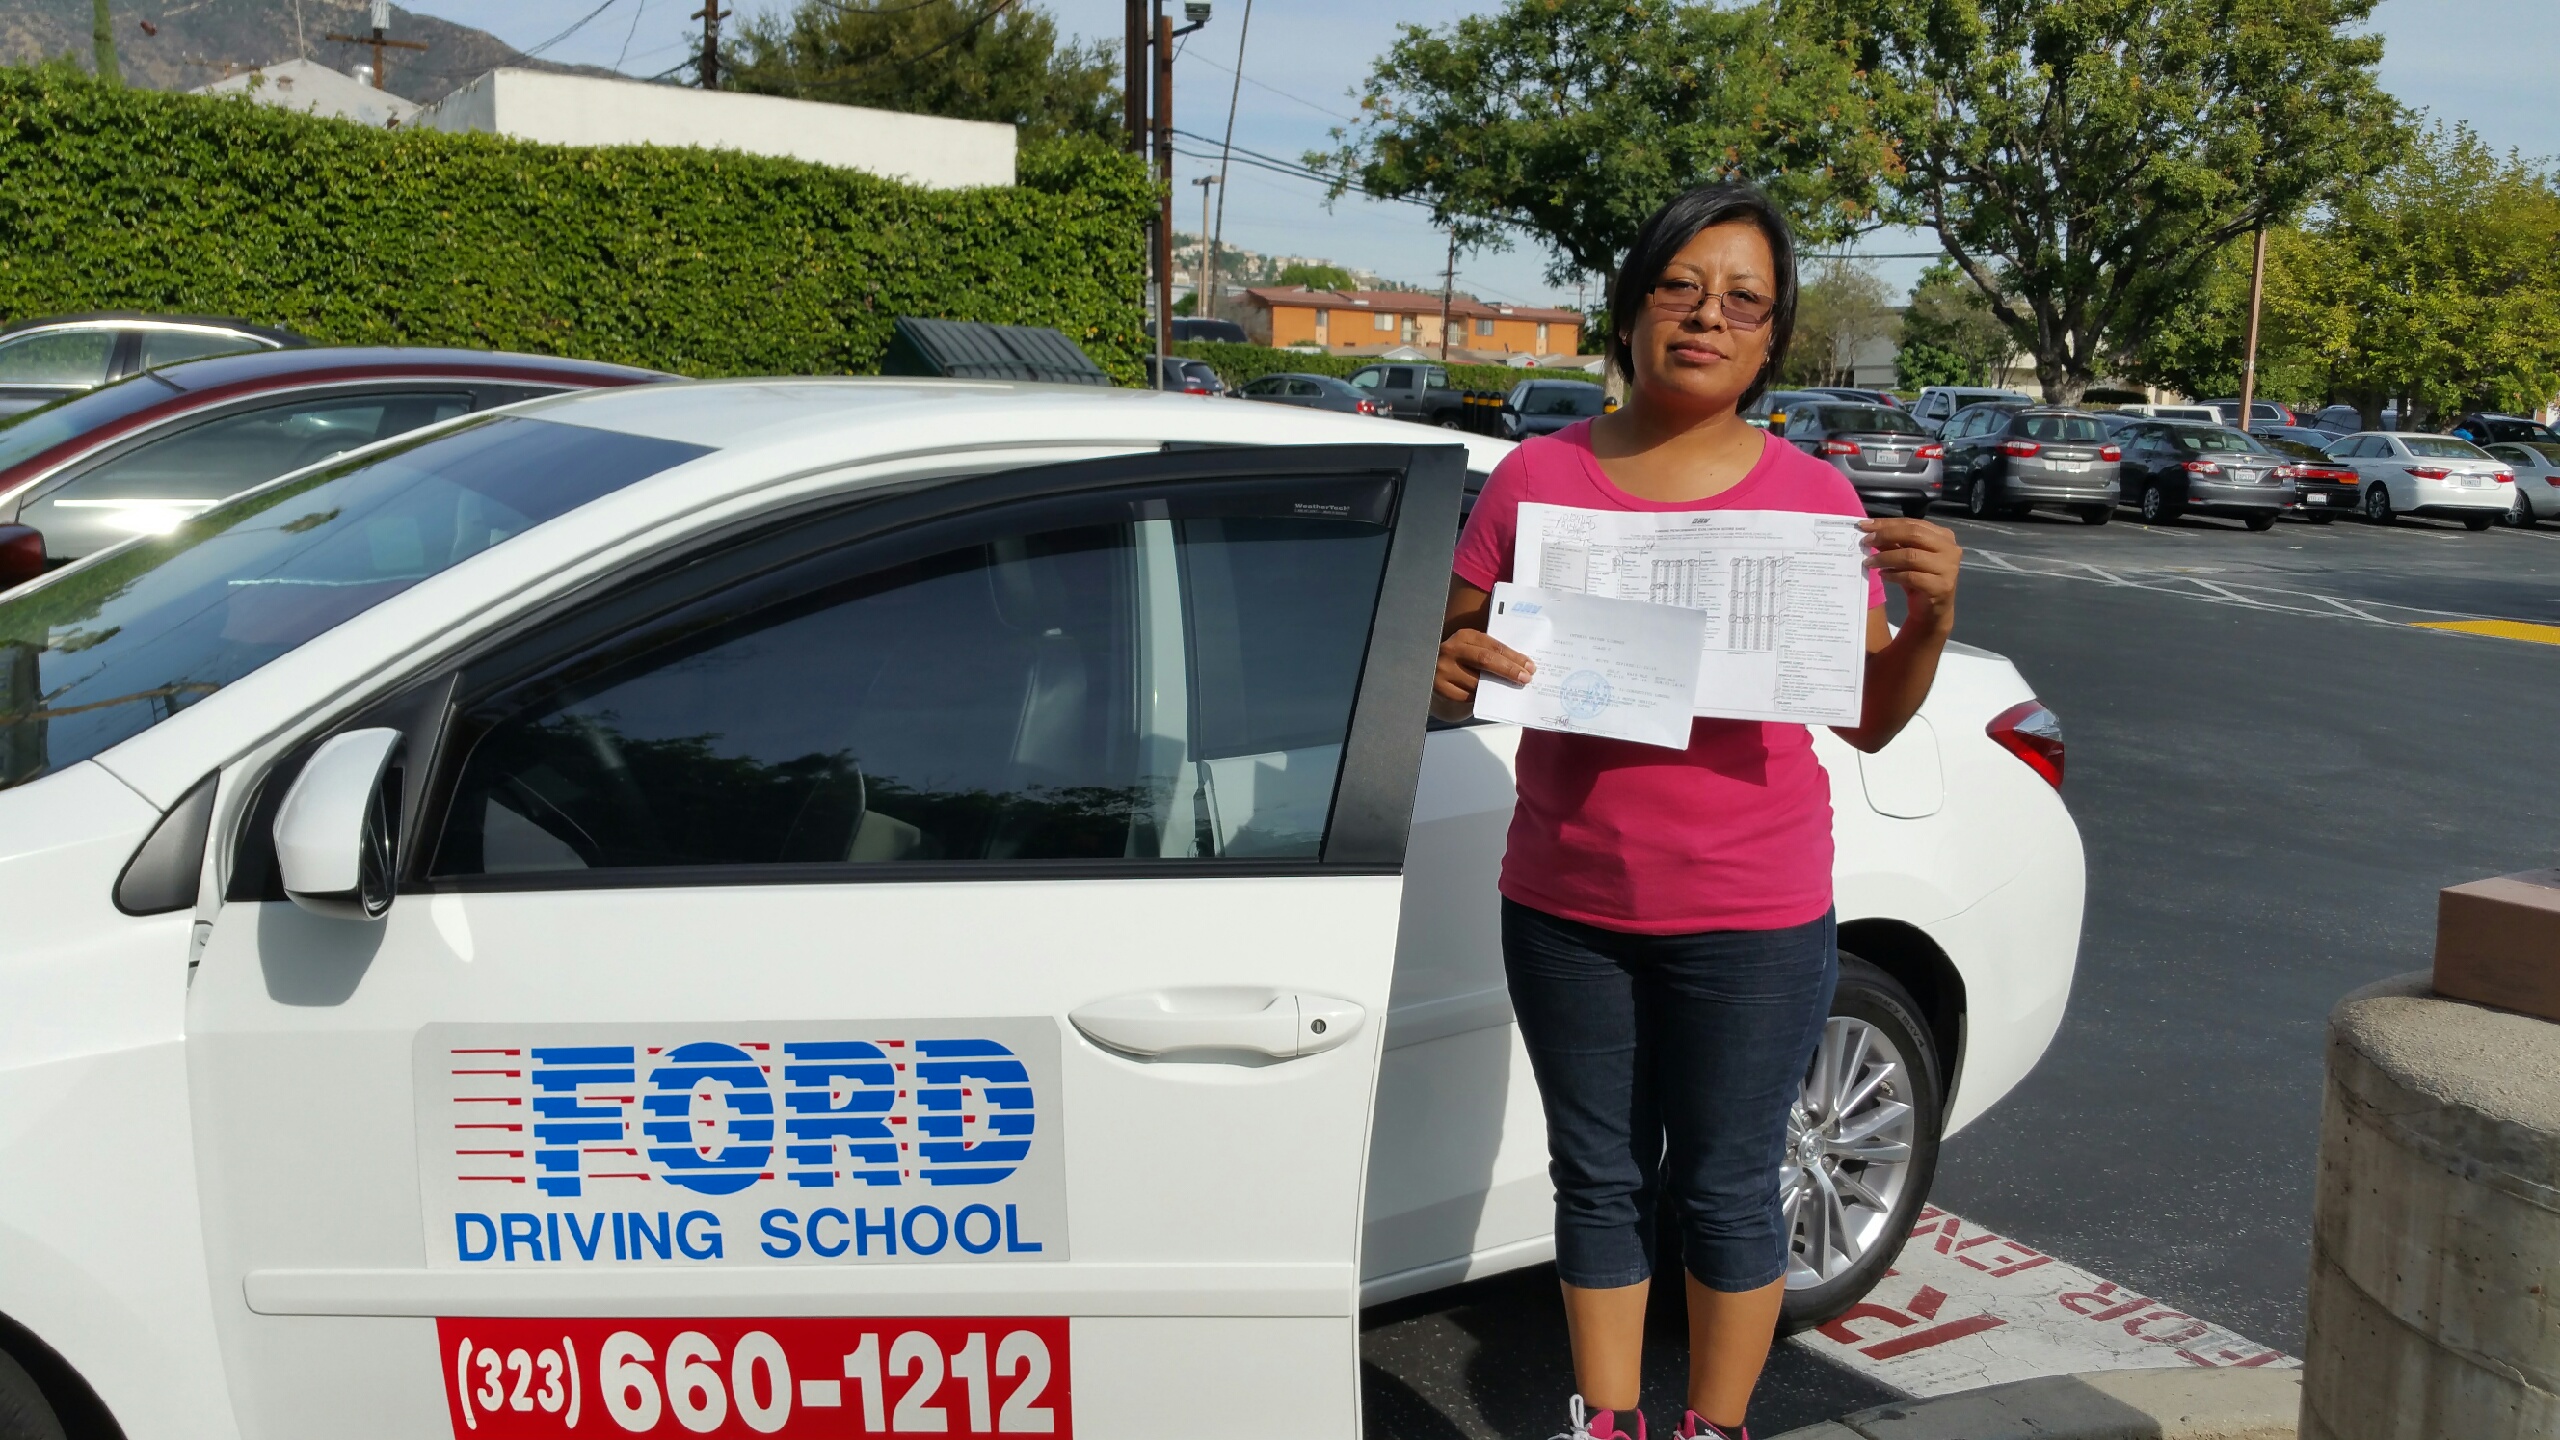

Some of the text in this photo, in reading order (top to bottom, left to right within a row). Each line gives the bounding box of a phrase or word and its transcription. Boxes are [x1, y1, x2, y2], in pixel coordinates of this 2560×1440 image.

[531, 1040, 1034, 1197] FORD
[455, 1204, 1042, 1261] DRIVING SCHOOL
[458, 1331, 1054, 1433] (323) 660-1212
